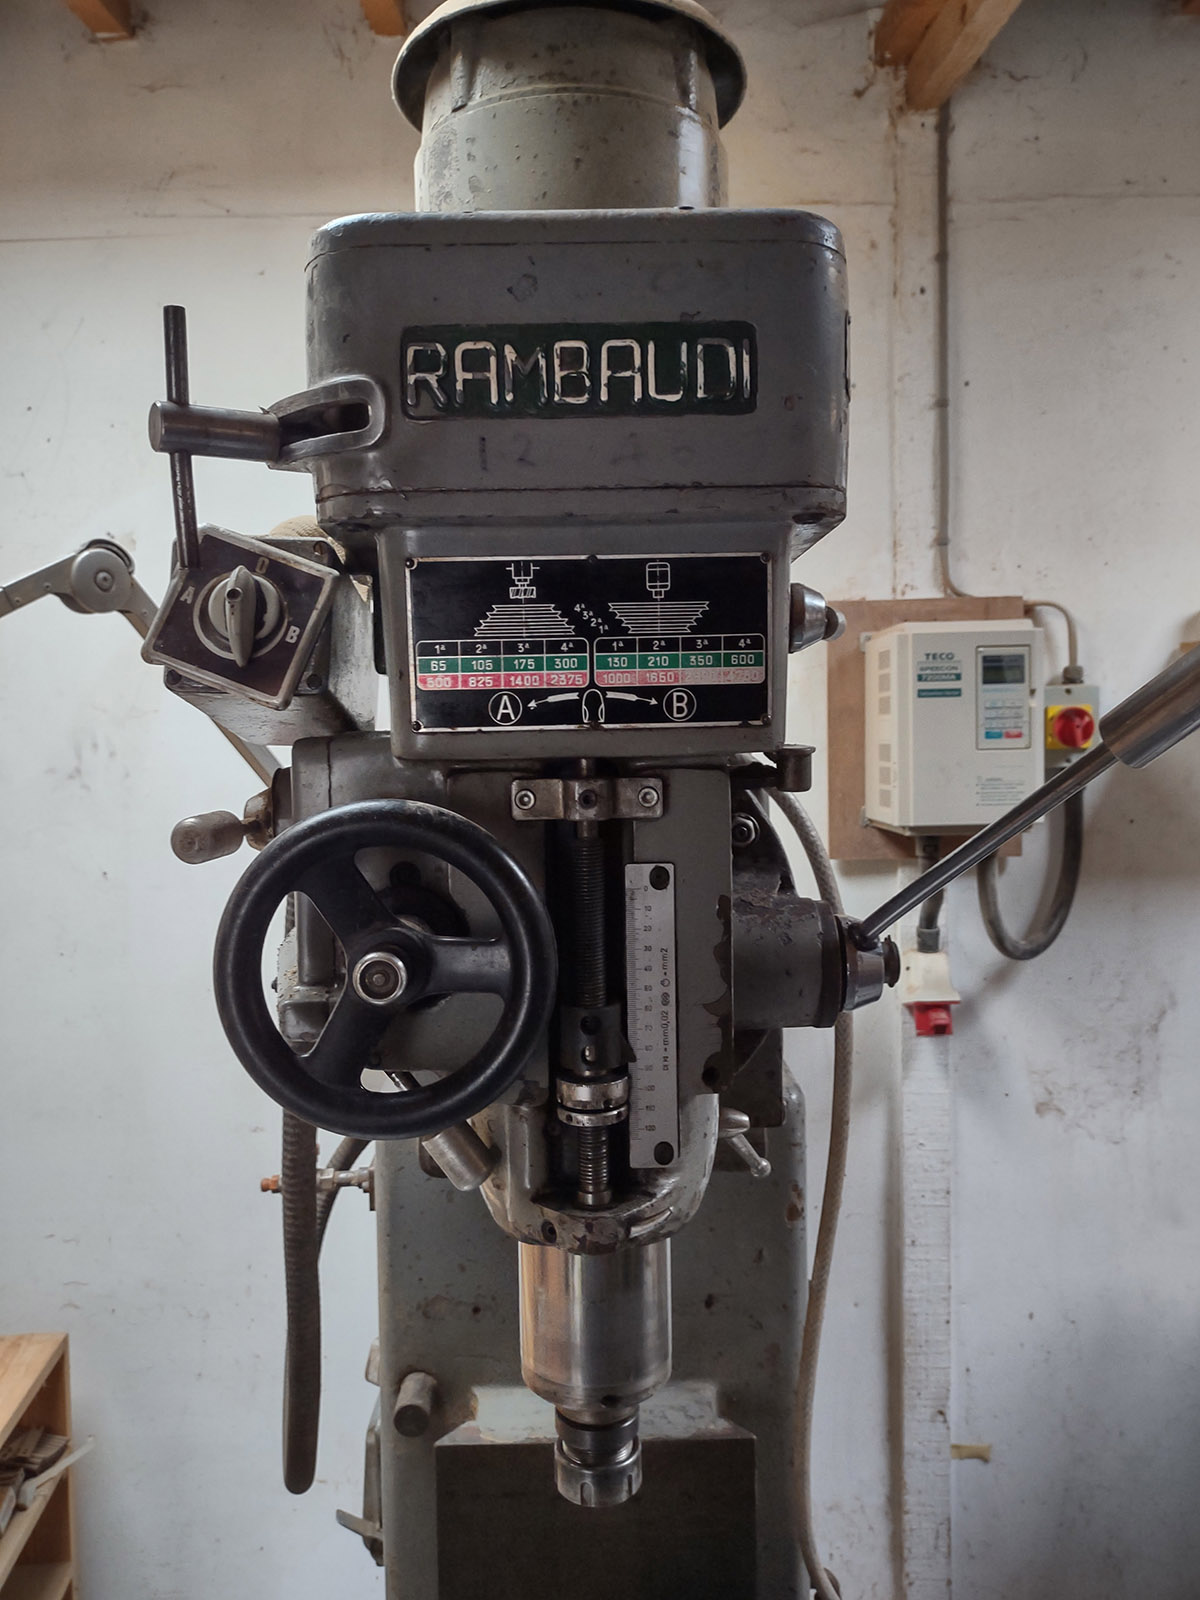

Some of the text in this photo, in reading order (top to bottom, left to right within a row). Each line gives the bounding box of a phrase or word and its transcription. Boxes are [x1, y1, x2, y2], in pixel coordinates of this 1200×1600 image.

[406, 338, 751, 408] RAMBAUDI
[180, 586, 196, 604] A
[285, 625, 301, 644] B
[607, 654, 754, 668] 130 210 350 600
[925, 652, 955, 660] TECO
[430, 658, 578, 671] 65 105 175 300
[426, 674, 583, 688] 500 825 1400 2375
[603, 673, 631, 684] 1000
[646, 672, 675, 683] 1650
[496, 695, 515, 721] A
[673, 692, 688, 717] B
